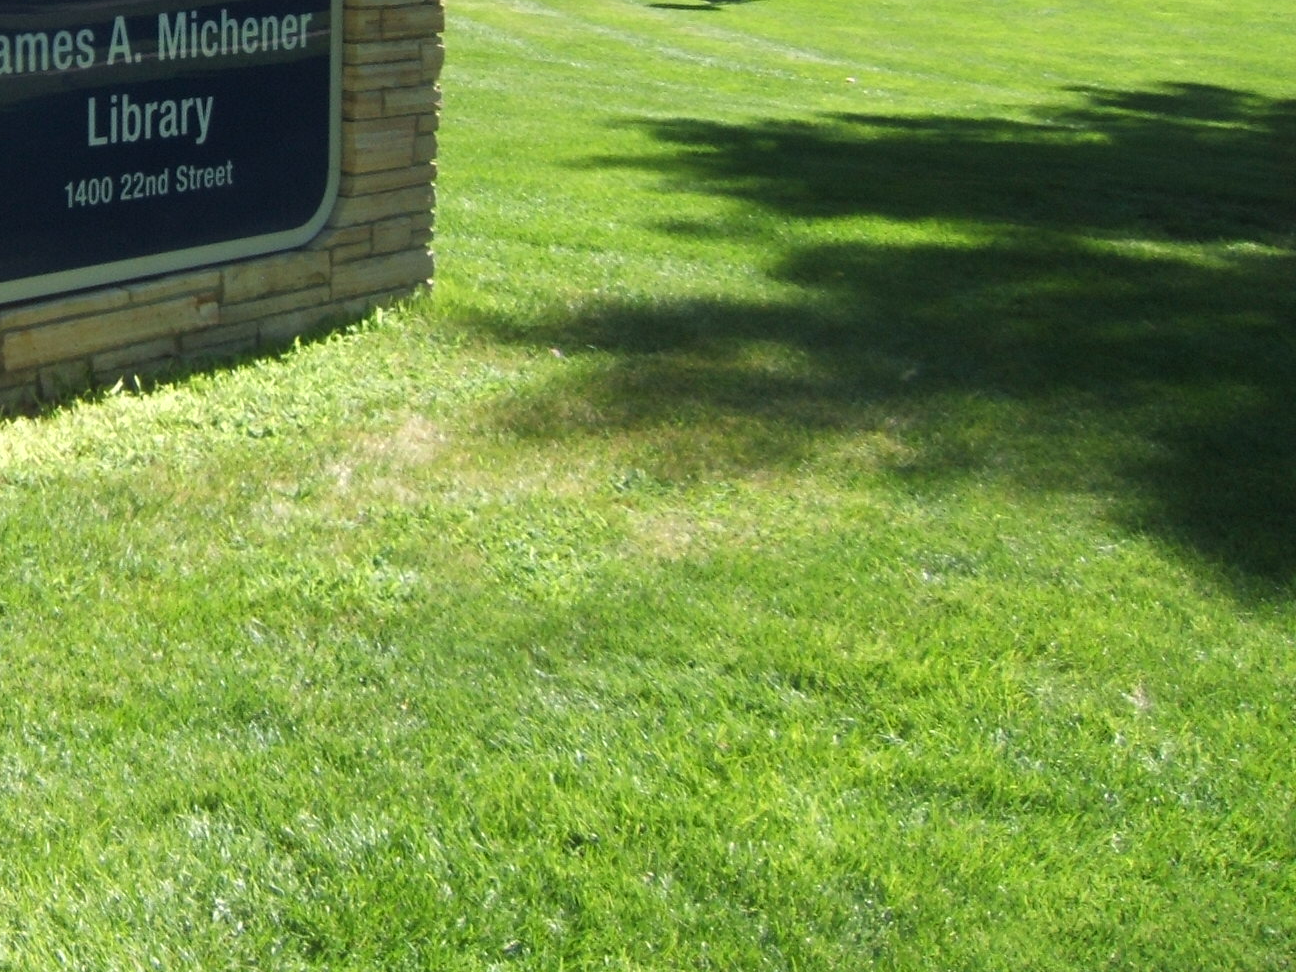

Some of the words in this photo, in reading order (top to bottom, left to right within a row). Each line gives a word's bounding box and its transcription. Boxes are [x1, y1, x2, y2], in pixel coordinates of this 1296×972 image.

[106, 15, 142, 65] A.
[158, 8, 313, 61] Michener
[88, 93, 214, 146] Library
[65, 176, 113, 208] 1400
[120, 167, 170, 200] 22nd
[176, 159, 234, 192] Street
